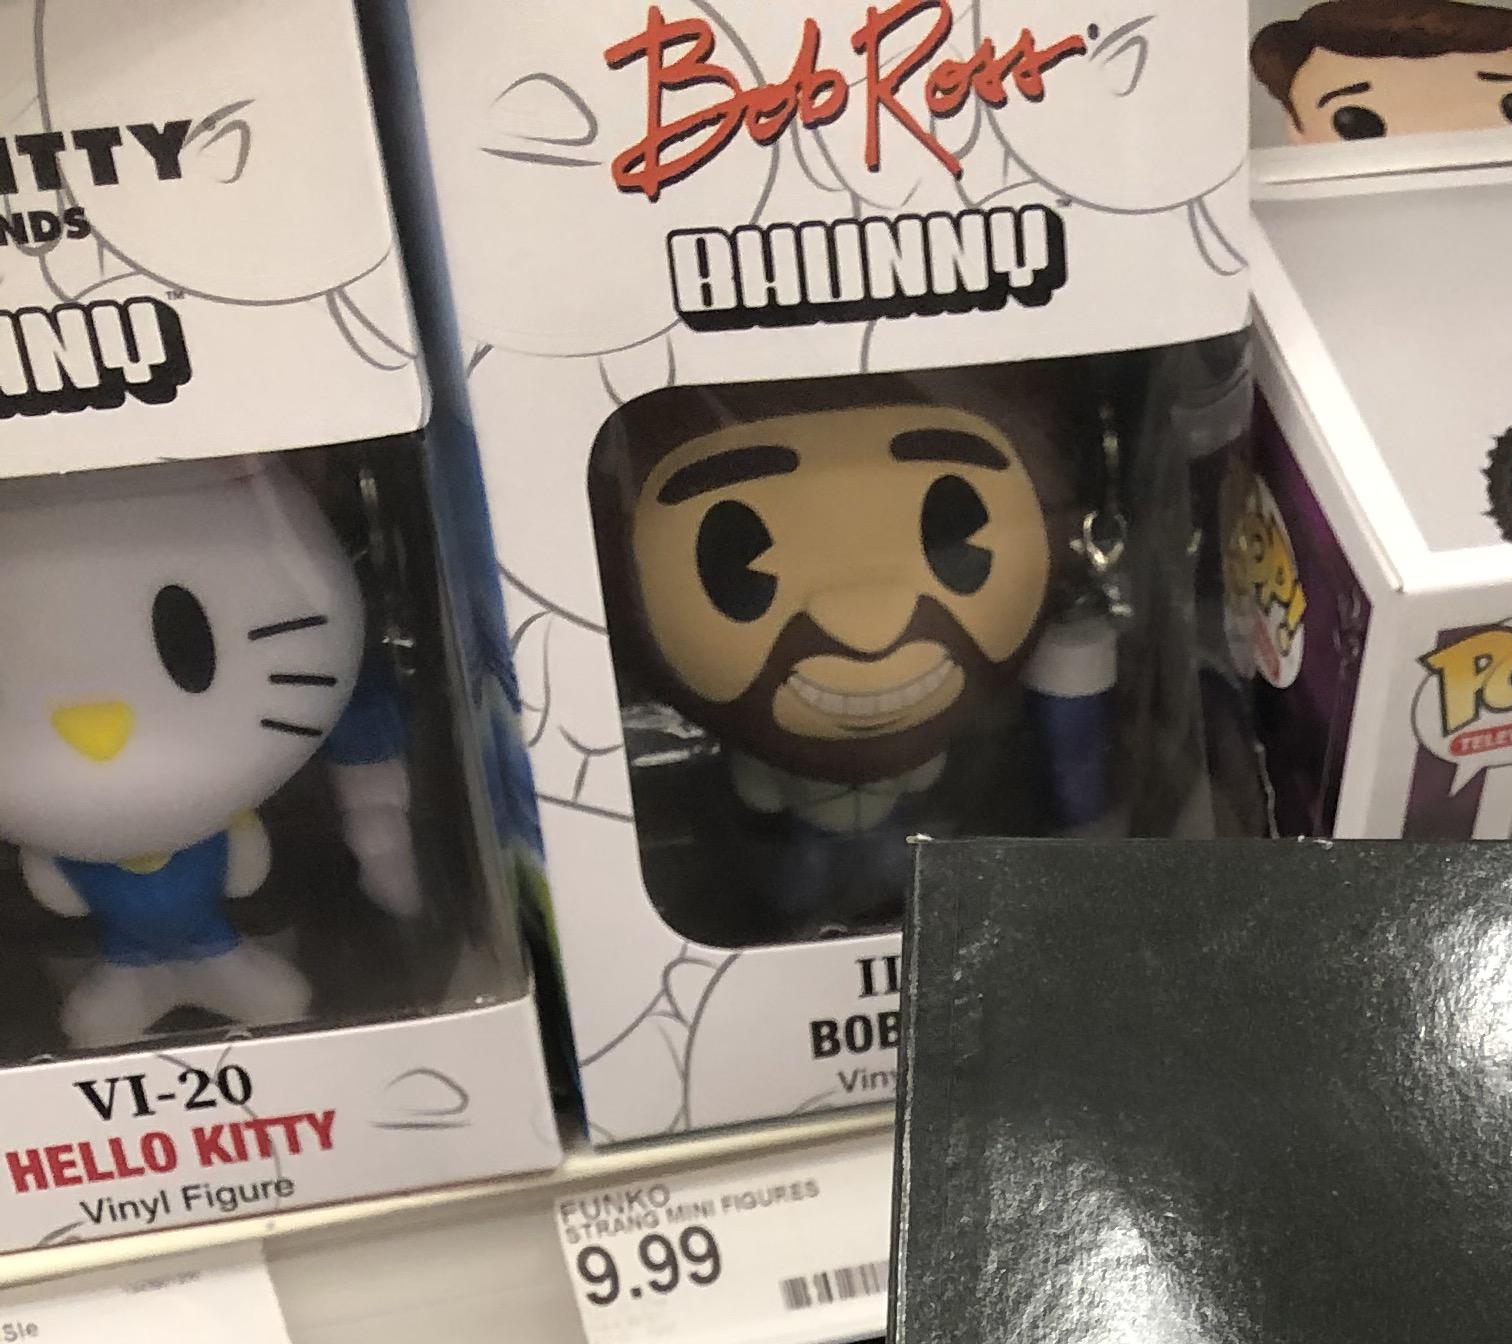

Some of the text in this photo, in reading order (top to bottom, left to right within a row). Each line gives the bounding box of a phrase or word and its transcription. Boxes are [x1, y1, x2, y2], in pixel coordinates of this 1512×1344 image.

[604, 0, 1086, 203] Bob Ross
[74, 1064, 253, 1121] VI-20
[5, 1109, 336, 1194] HELLO KITTY
[79, 1173, 295, 1226] Vinyl Figure
[560, 1184, 670, 1225] FUNKO
[667, 1200, 715, 1225] MINI
[721, 1178, 820, 1216] FIGURES
[577, 1225, 722, 1305] 9.99
